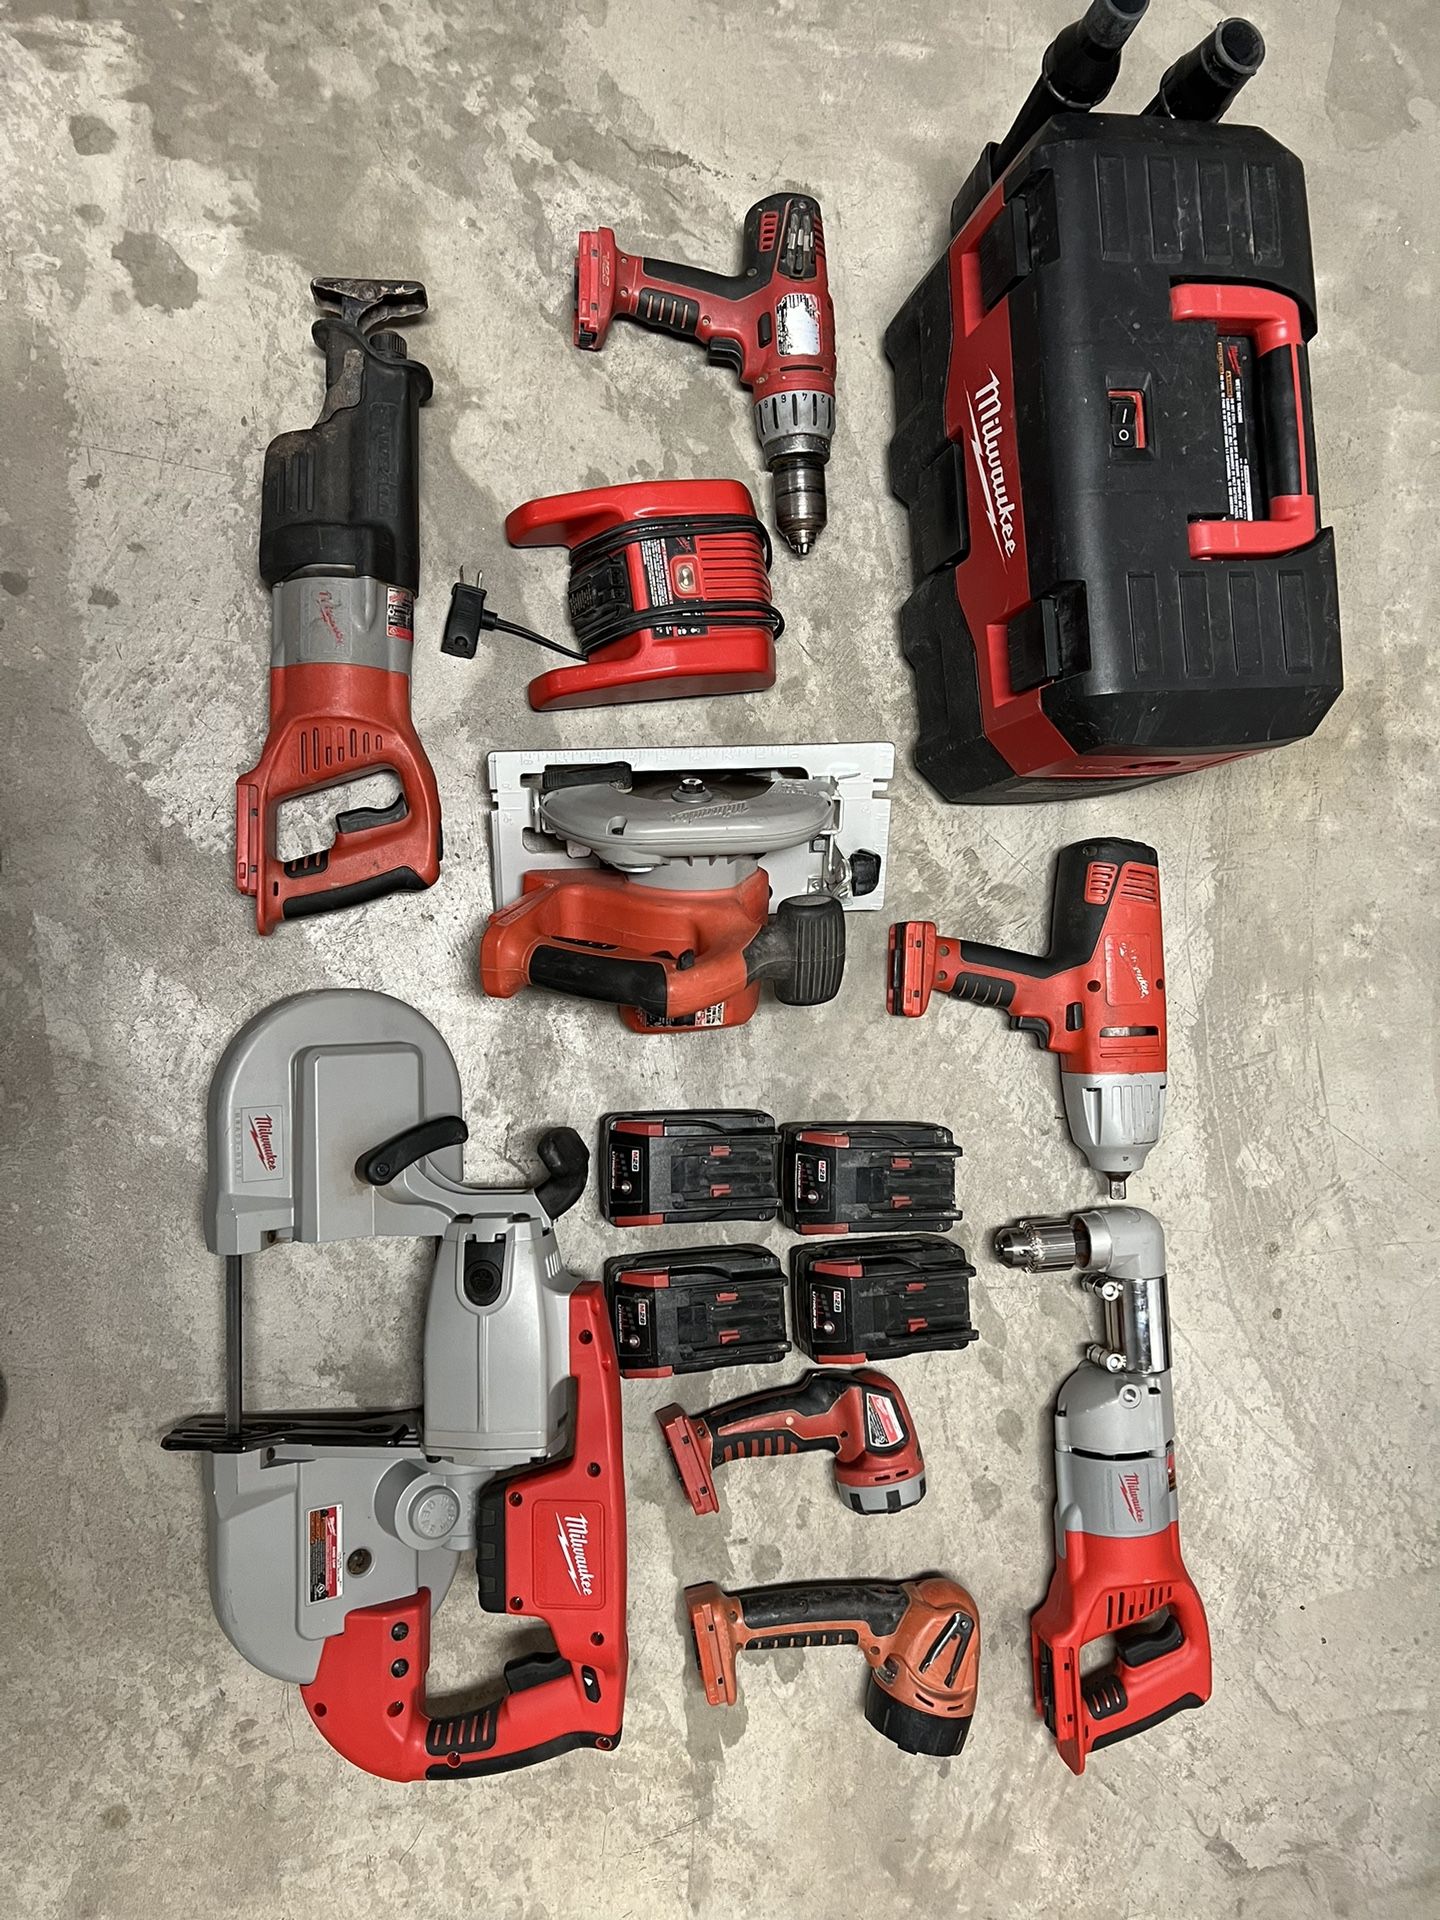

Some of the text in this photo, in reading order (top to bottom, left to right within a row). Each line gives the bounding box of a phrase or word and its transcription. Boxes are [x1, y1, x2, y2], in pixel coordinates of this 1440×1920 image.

[802, 392, 808, 401] 4
[974, 367, 1017, 559] Milwaukee
[254, 1113, 278, 1171] Milwaukee
[638, 1303, 647, 1325] M28
[833, 1290, 841, 1312] M28
[1123, 1472, 1144, 1523] Milwaukee
[564, 1512, 594, 1597] Milwaukee
